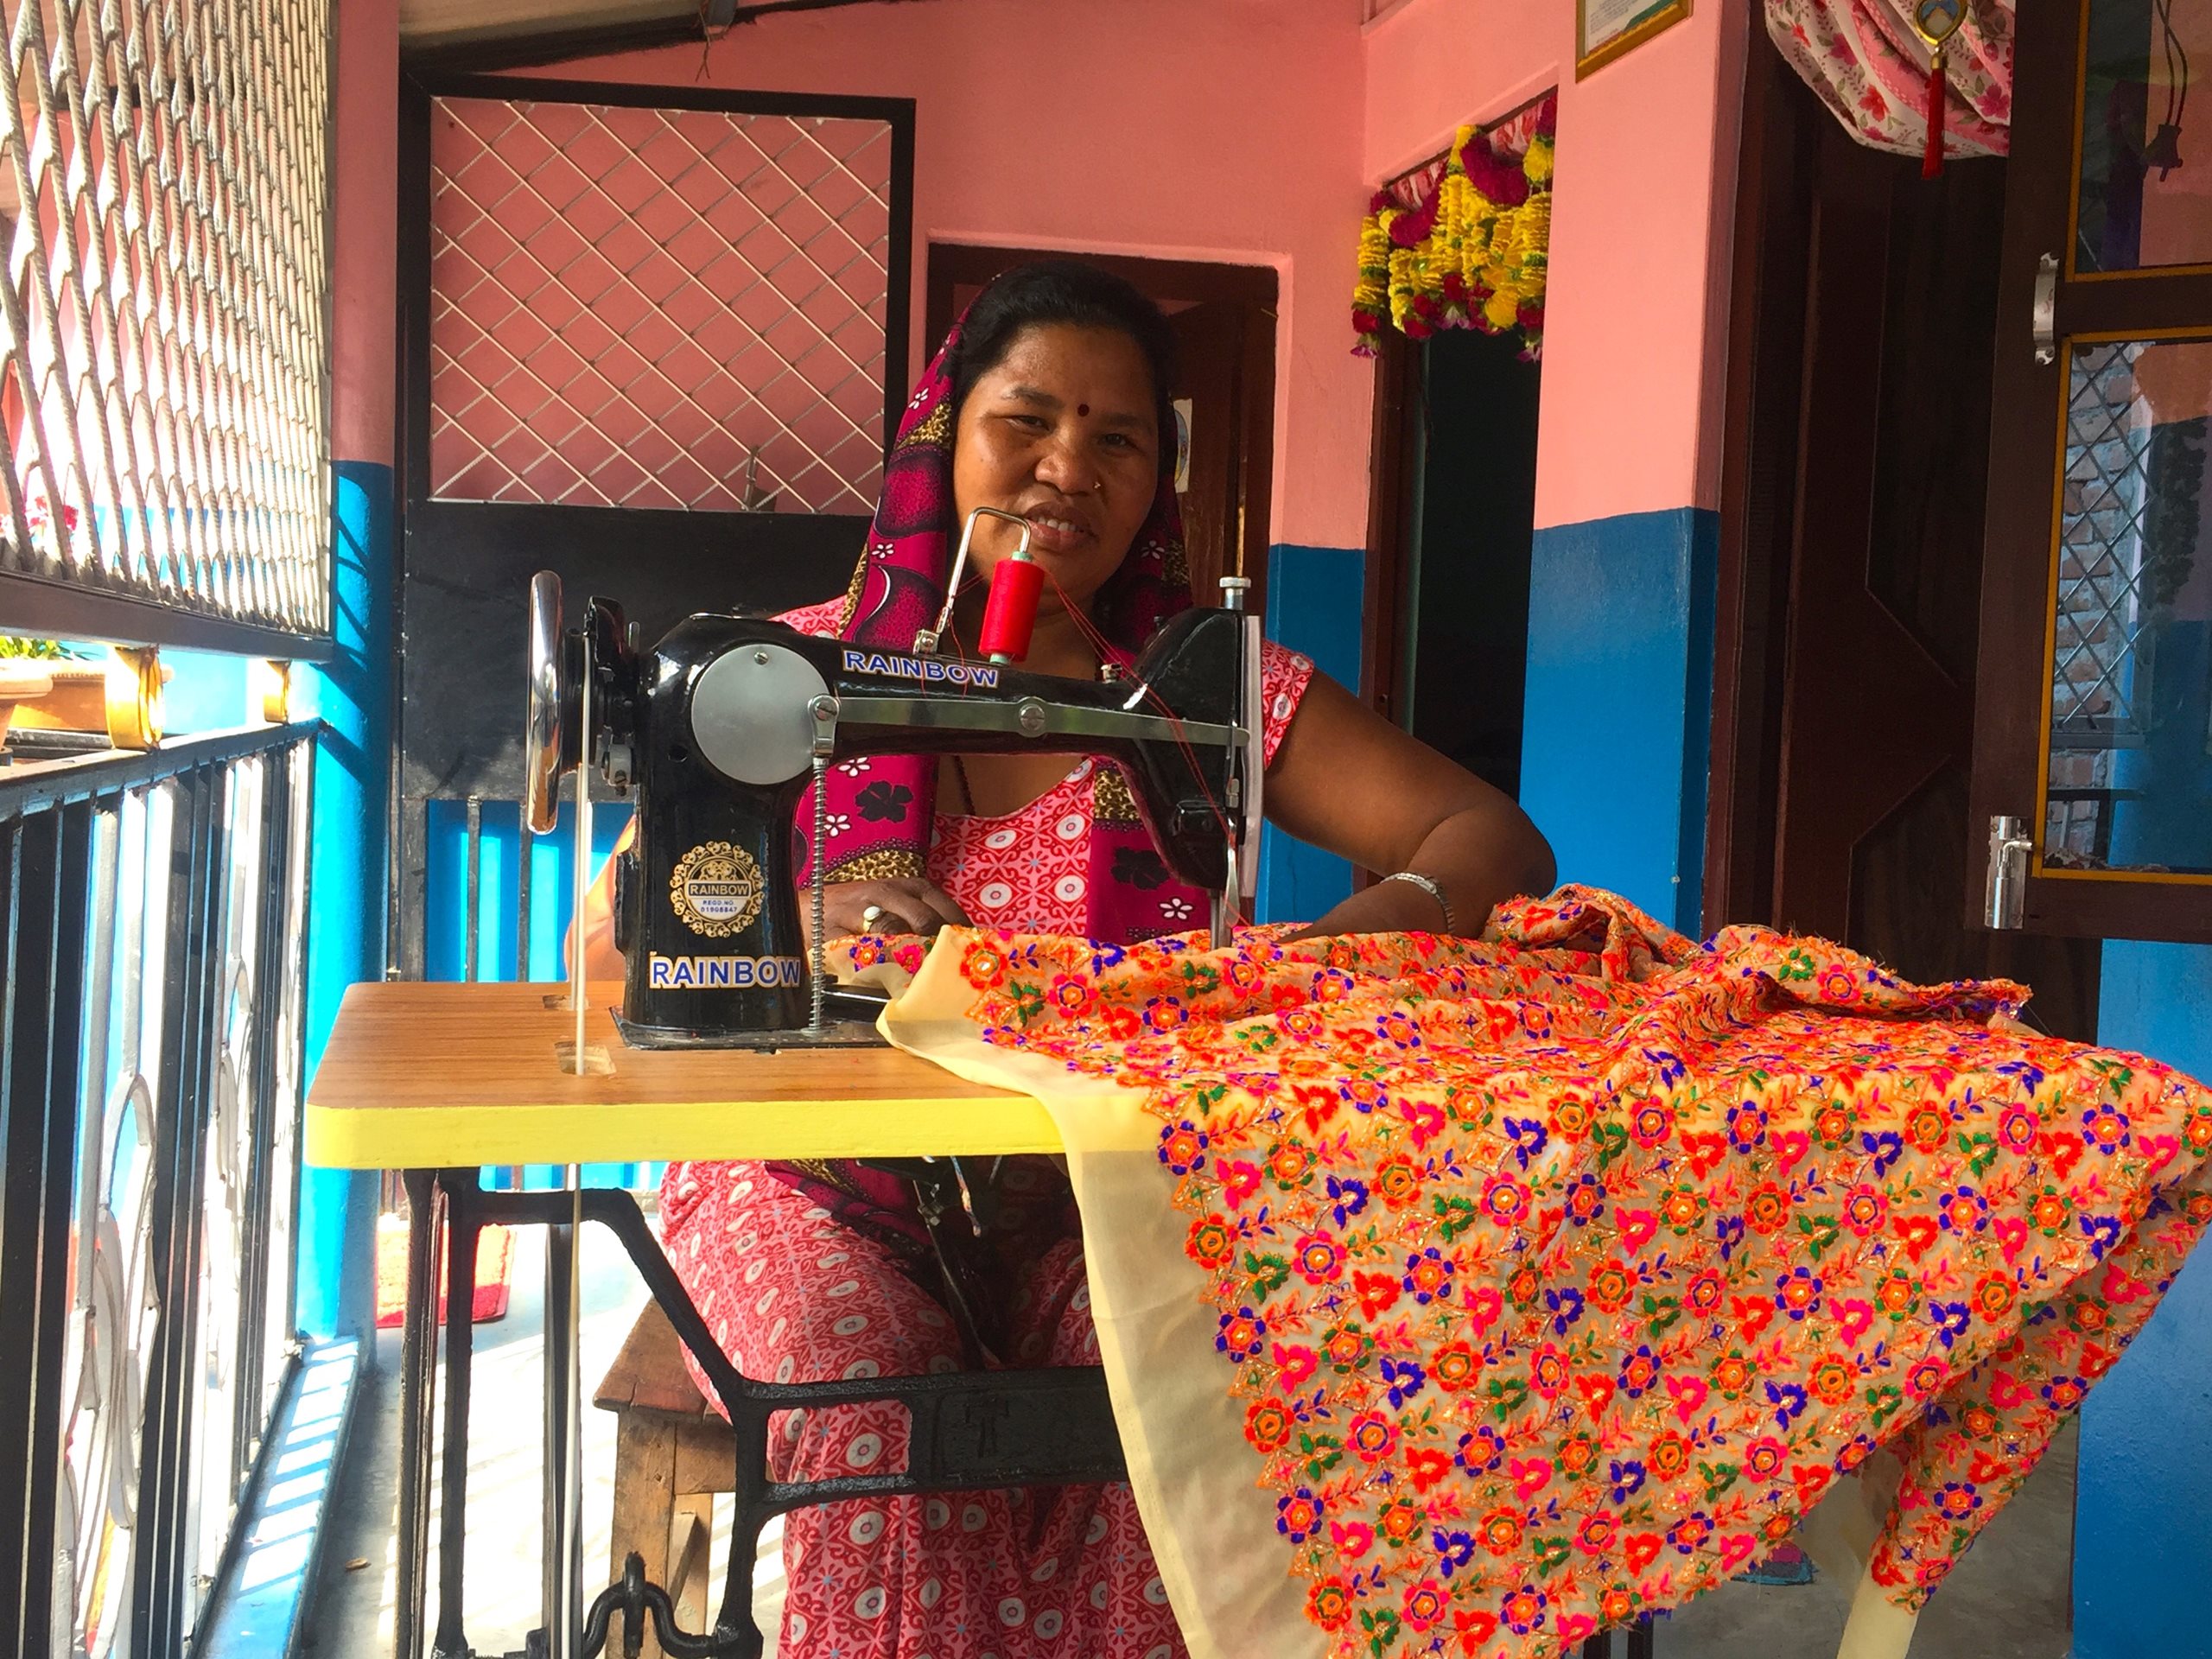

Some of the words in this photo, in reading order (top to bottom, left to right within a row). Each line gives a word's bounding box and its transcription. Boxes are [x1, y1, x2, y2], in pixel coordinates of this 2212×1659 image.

[843, 650, 998, 688] RAINBOW
[690, 883, 748, 895] RAINBOW
[651, 959, 802, 987] RAINBOW
